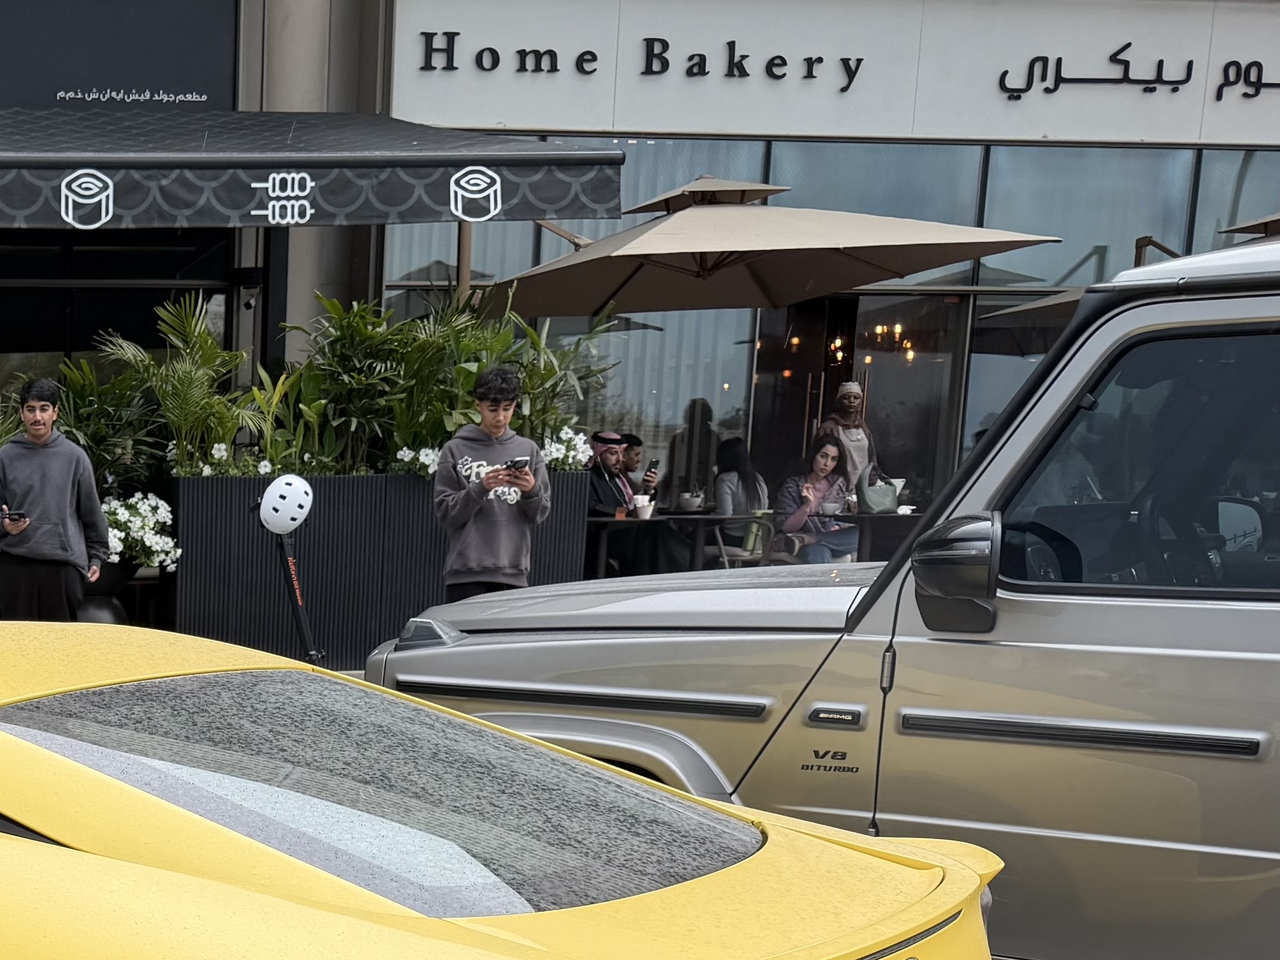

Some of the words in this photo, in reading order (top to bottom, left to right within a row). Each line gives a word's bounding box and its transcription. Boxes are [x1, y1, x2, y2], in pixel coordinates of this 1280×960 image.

[419, 31, 599, 76] Home
[639, 37, 865, 94] Bakery
[999, 41, 1194, 101] بيكري
[1216, 60, 1280, 102] وم
[124, 88, 151, 103] فيش
[152, 90, 175, 104] جولد
[175, 91, 208, 104] مطعم
[813, 749, 848, 761] V8
[800, 764, 860, 774] BITURBO
